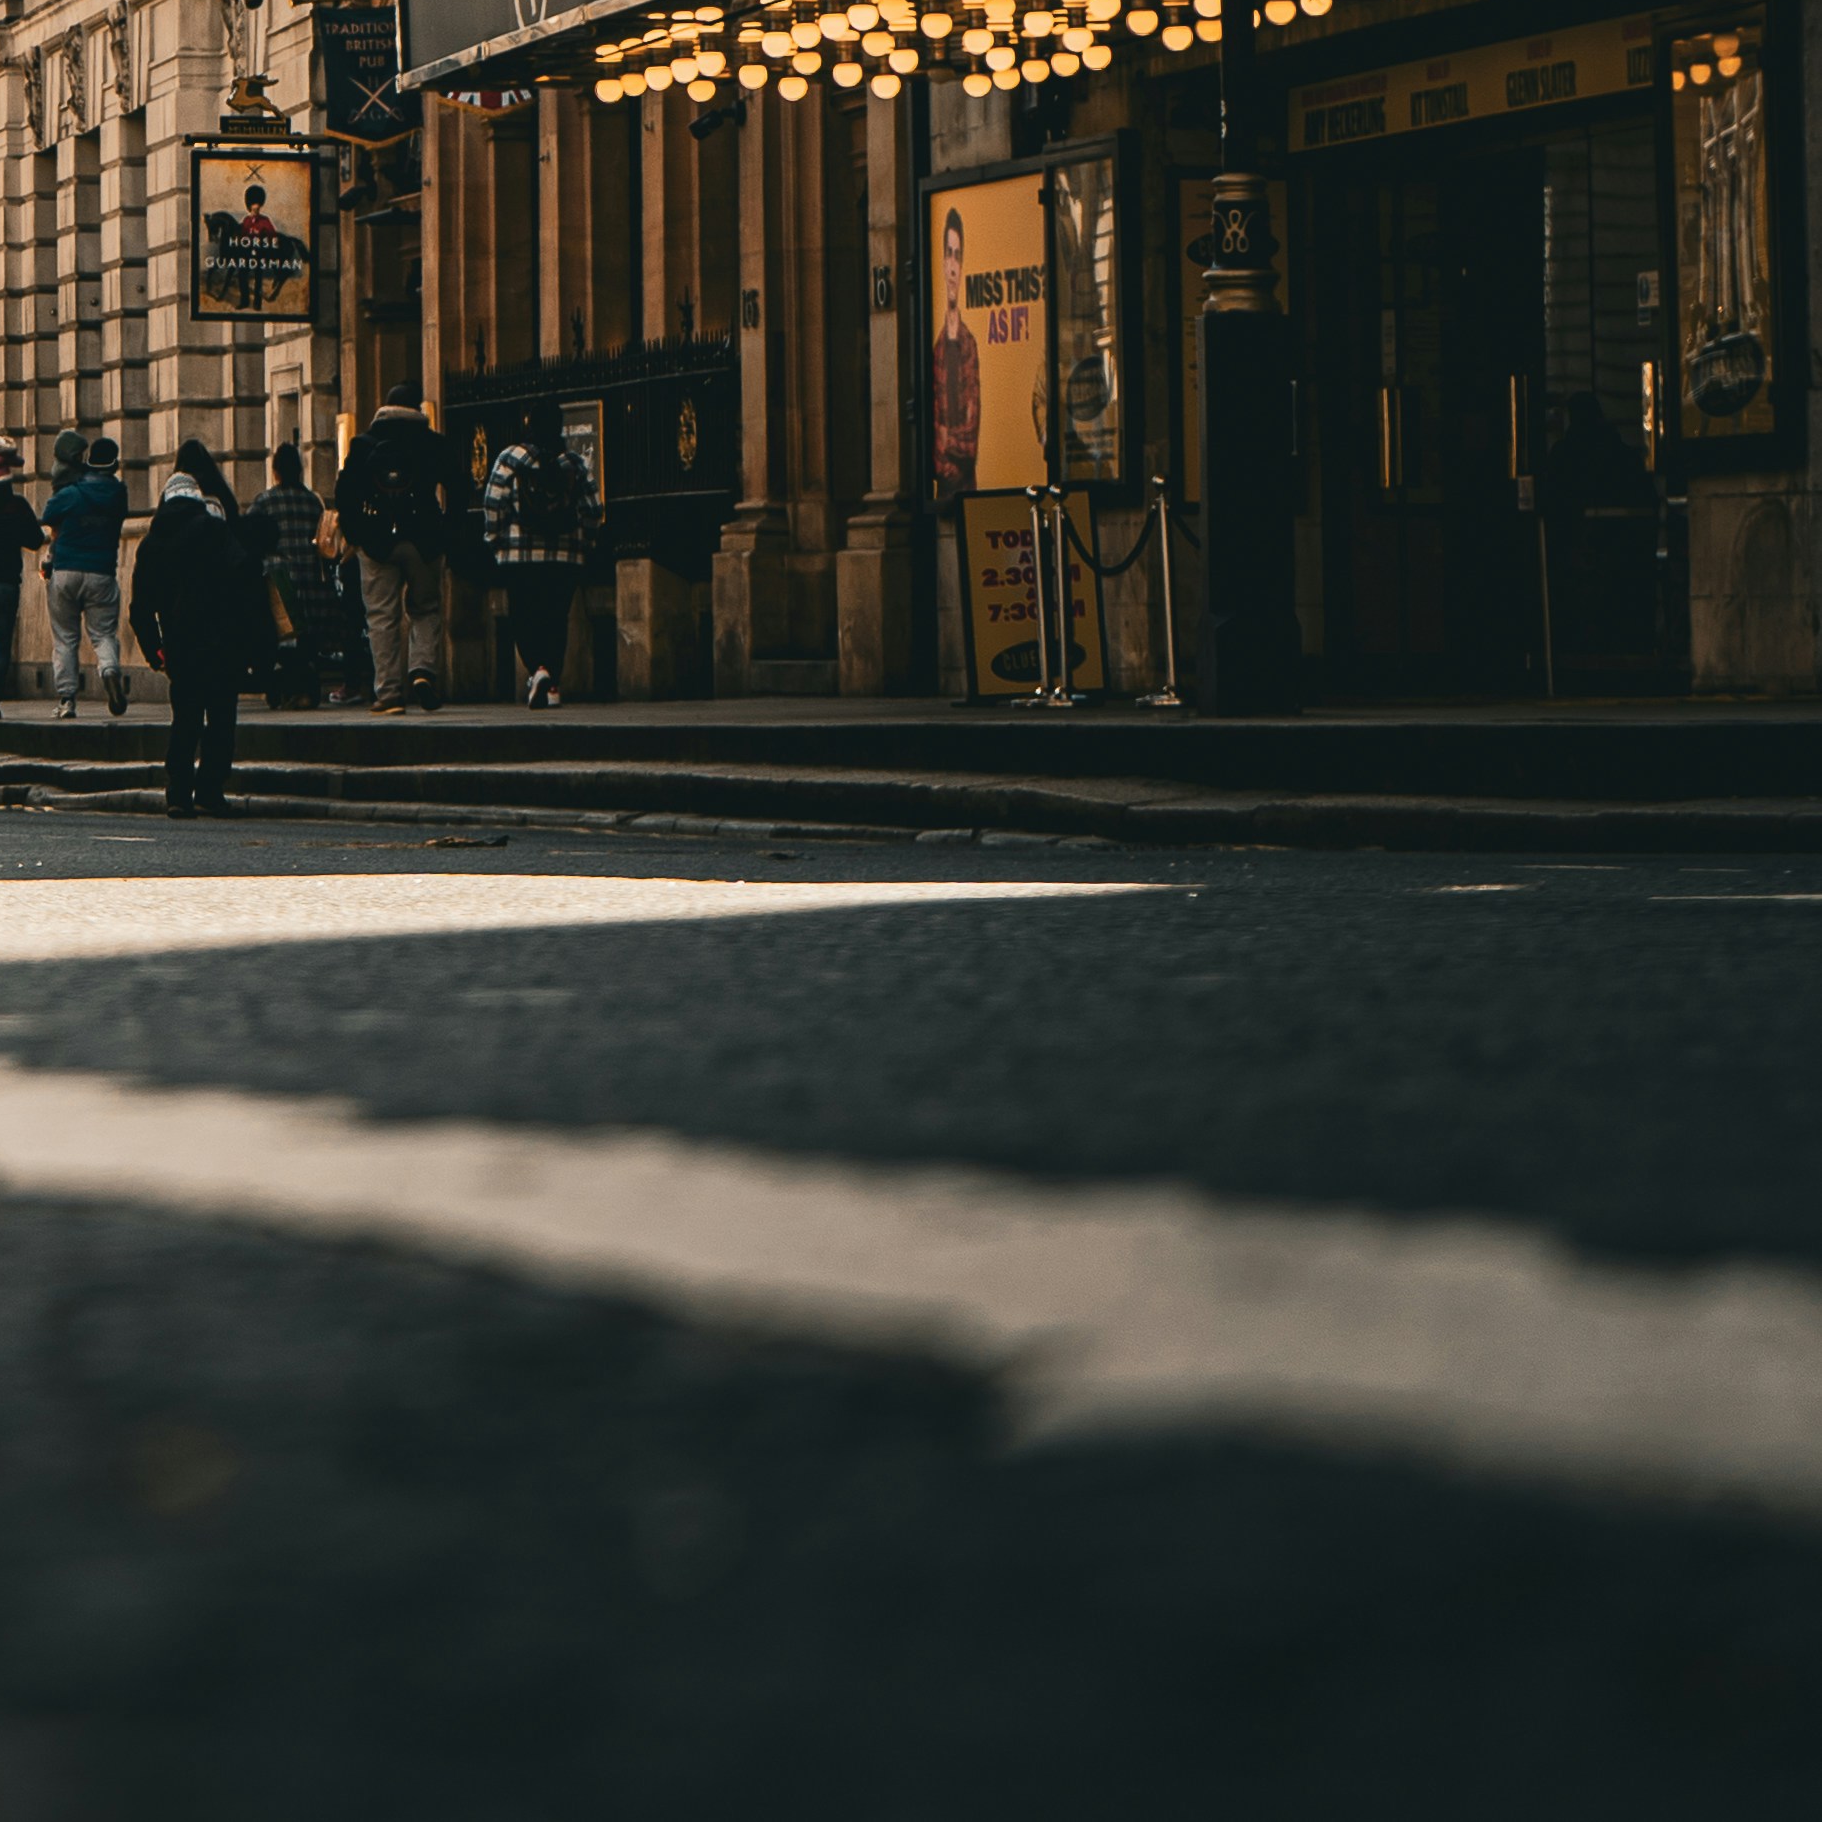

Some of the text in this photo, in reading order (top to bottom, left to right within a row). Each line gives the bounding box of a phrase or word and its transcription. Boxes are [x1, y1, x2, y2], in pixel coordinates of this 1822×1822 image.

[359, 55, 385, 68] PUB
[228, 236, 279, 249] HORSE
[204, 256, 303, 271] GUARDSMAN
[966, 269, 1004, 309] MISS
[988, 306, 1029, 345] AS IF!
